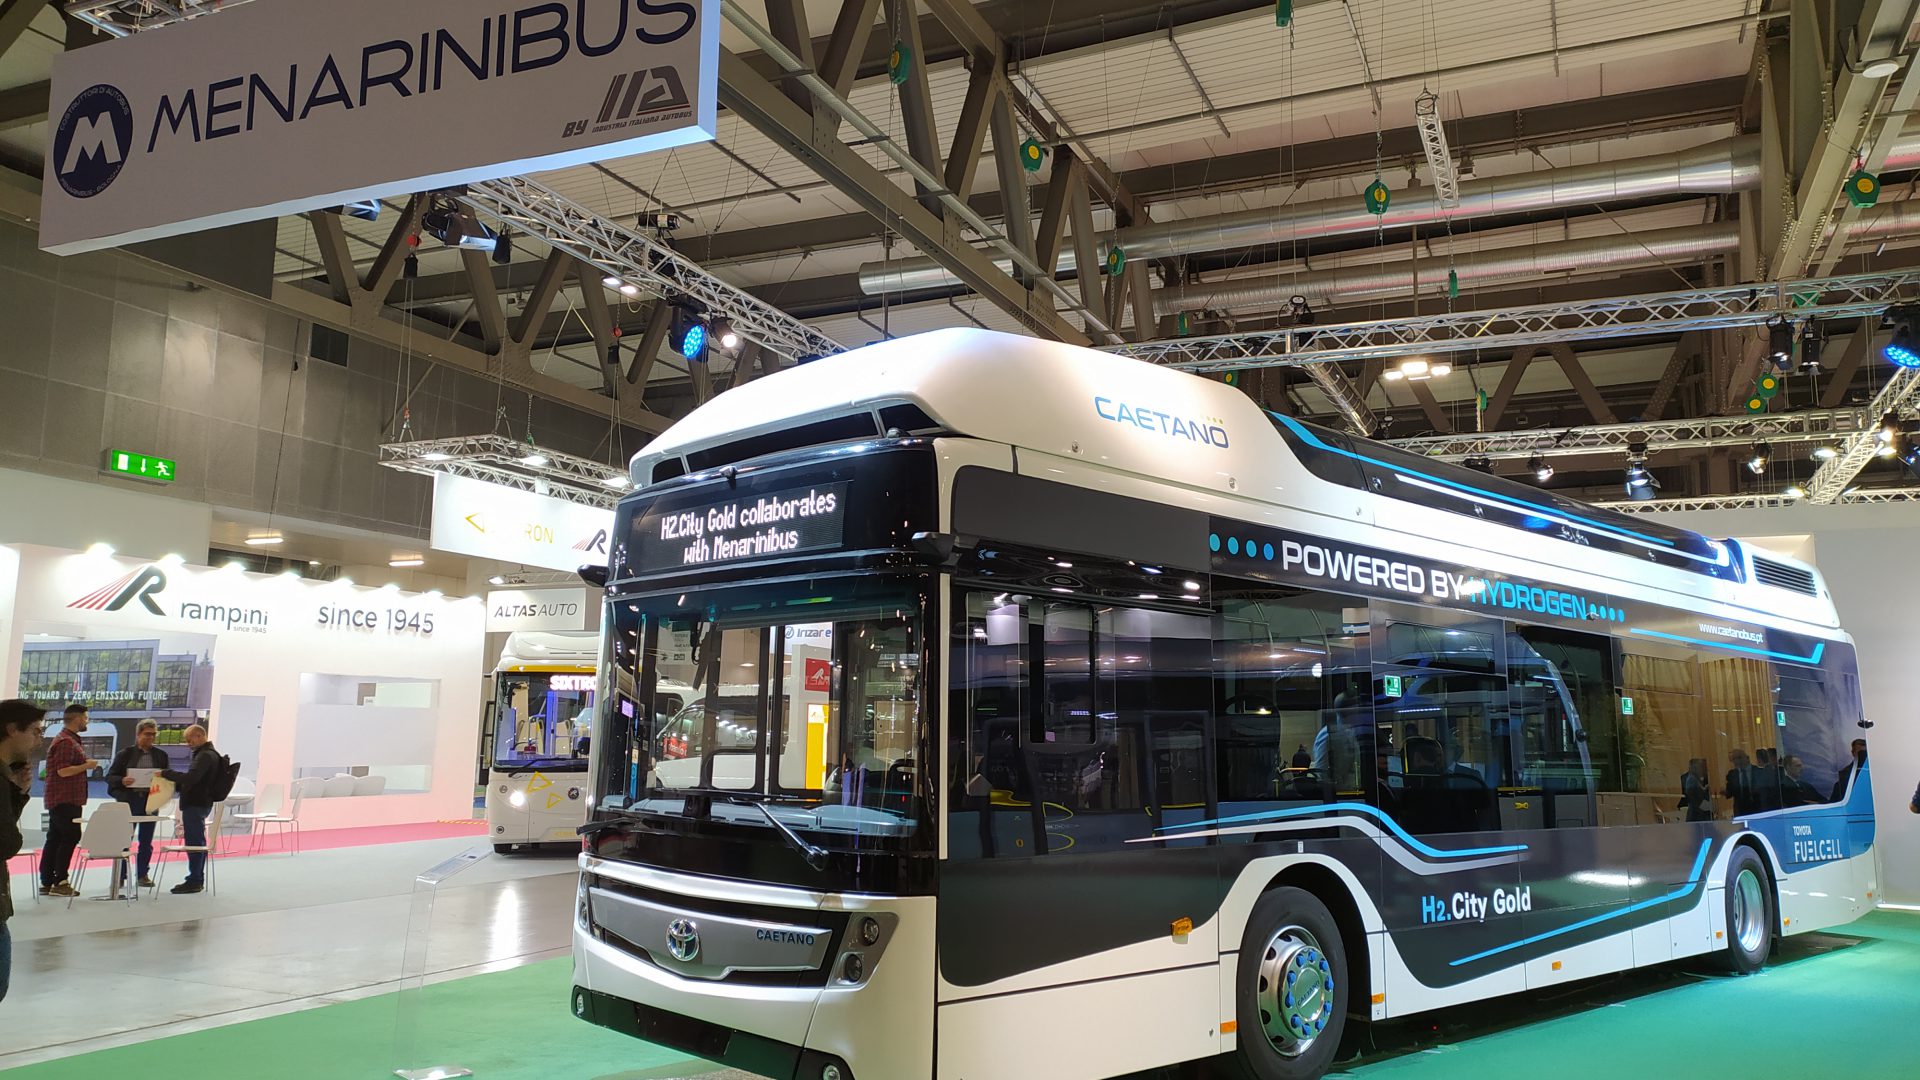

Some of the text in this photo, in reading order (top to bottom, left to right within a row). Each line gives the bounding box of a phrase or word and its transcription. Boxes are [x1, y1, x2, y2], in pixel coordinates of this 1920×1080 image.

[146, 0, 697, 153] MENARINIBUS
[561, 110, 692, 138] BY INDUSTRIA ITALIANA AUTOBUS
[1094, 396, 1229, 449] CAETANO
[661, 489, 836, 540] H2.City Gold collaborates
[684, 527, 799, 564] with Menarinibus
[1282, 540, 1588, 620] POWERED BY HYDROGEN
[181, 602, 268, 630] rampini
[318, 601, 434, 634] since 1945
[494, 603, 578, 618] ALTAS AUTO
[233, 625, 267, 634] since 1945
[797, 628, 824, 638] Irizar
[1698, 623, 1763, 644] www.caetanobus.pt
[33, 690, 60, 700] TOWARD
[73, 690, 91, 700] ZERO
[95, 690, 134, 700] EMISSION
[138, 690, 168, 700] FUTURE
[1793, 825, 1812, 836] TOYOTA
[1794, 838, 1843, 863] FUELCELL
[1493, 885, 1532, 915] Gold
[756, 929, 815, 945] CAETANO
